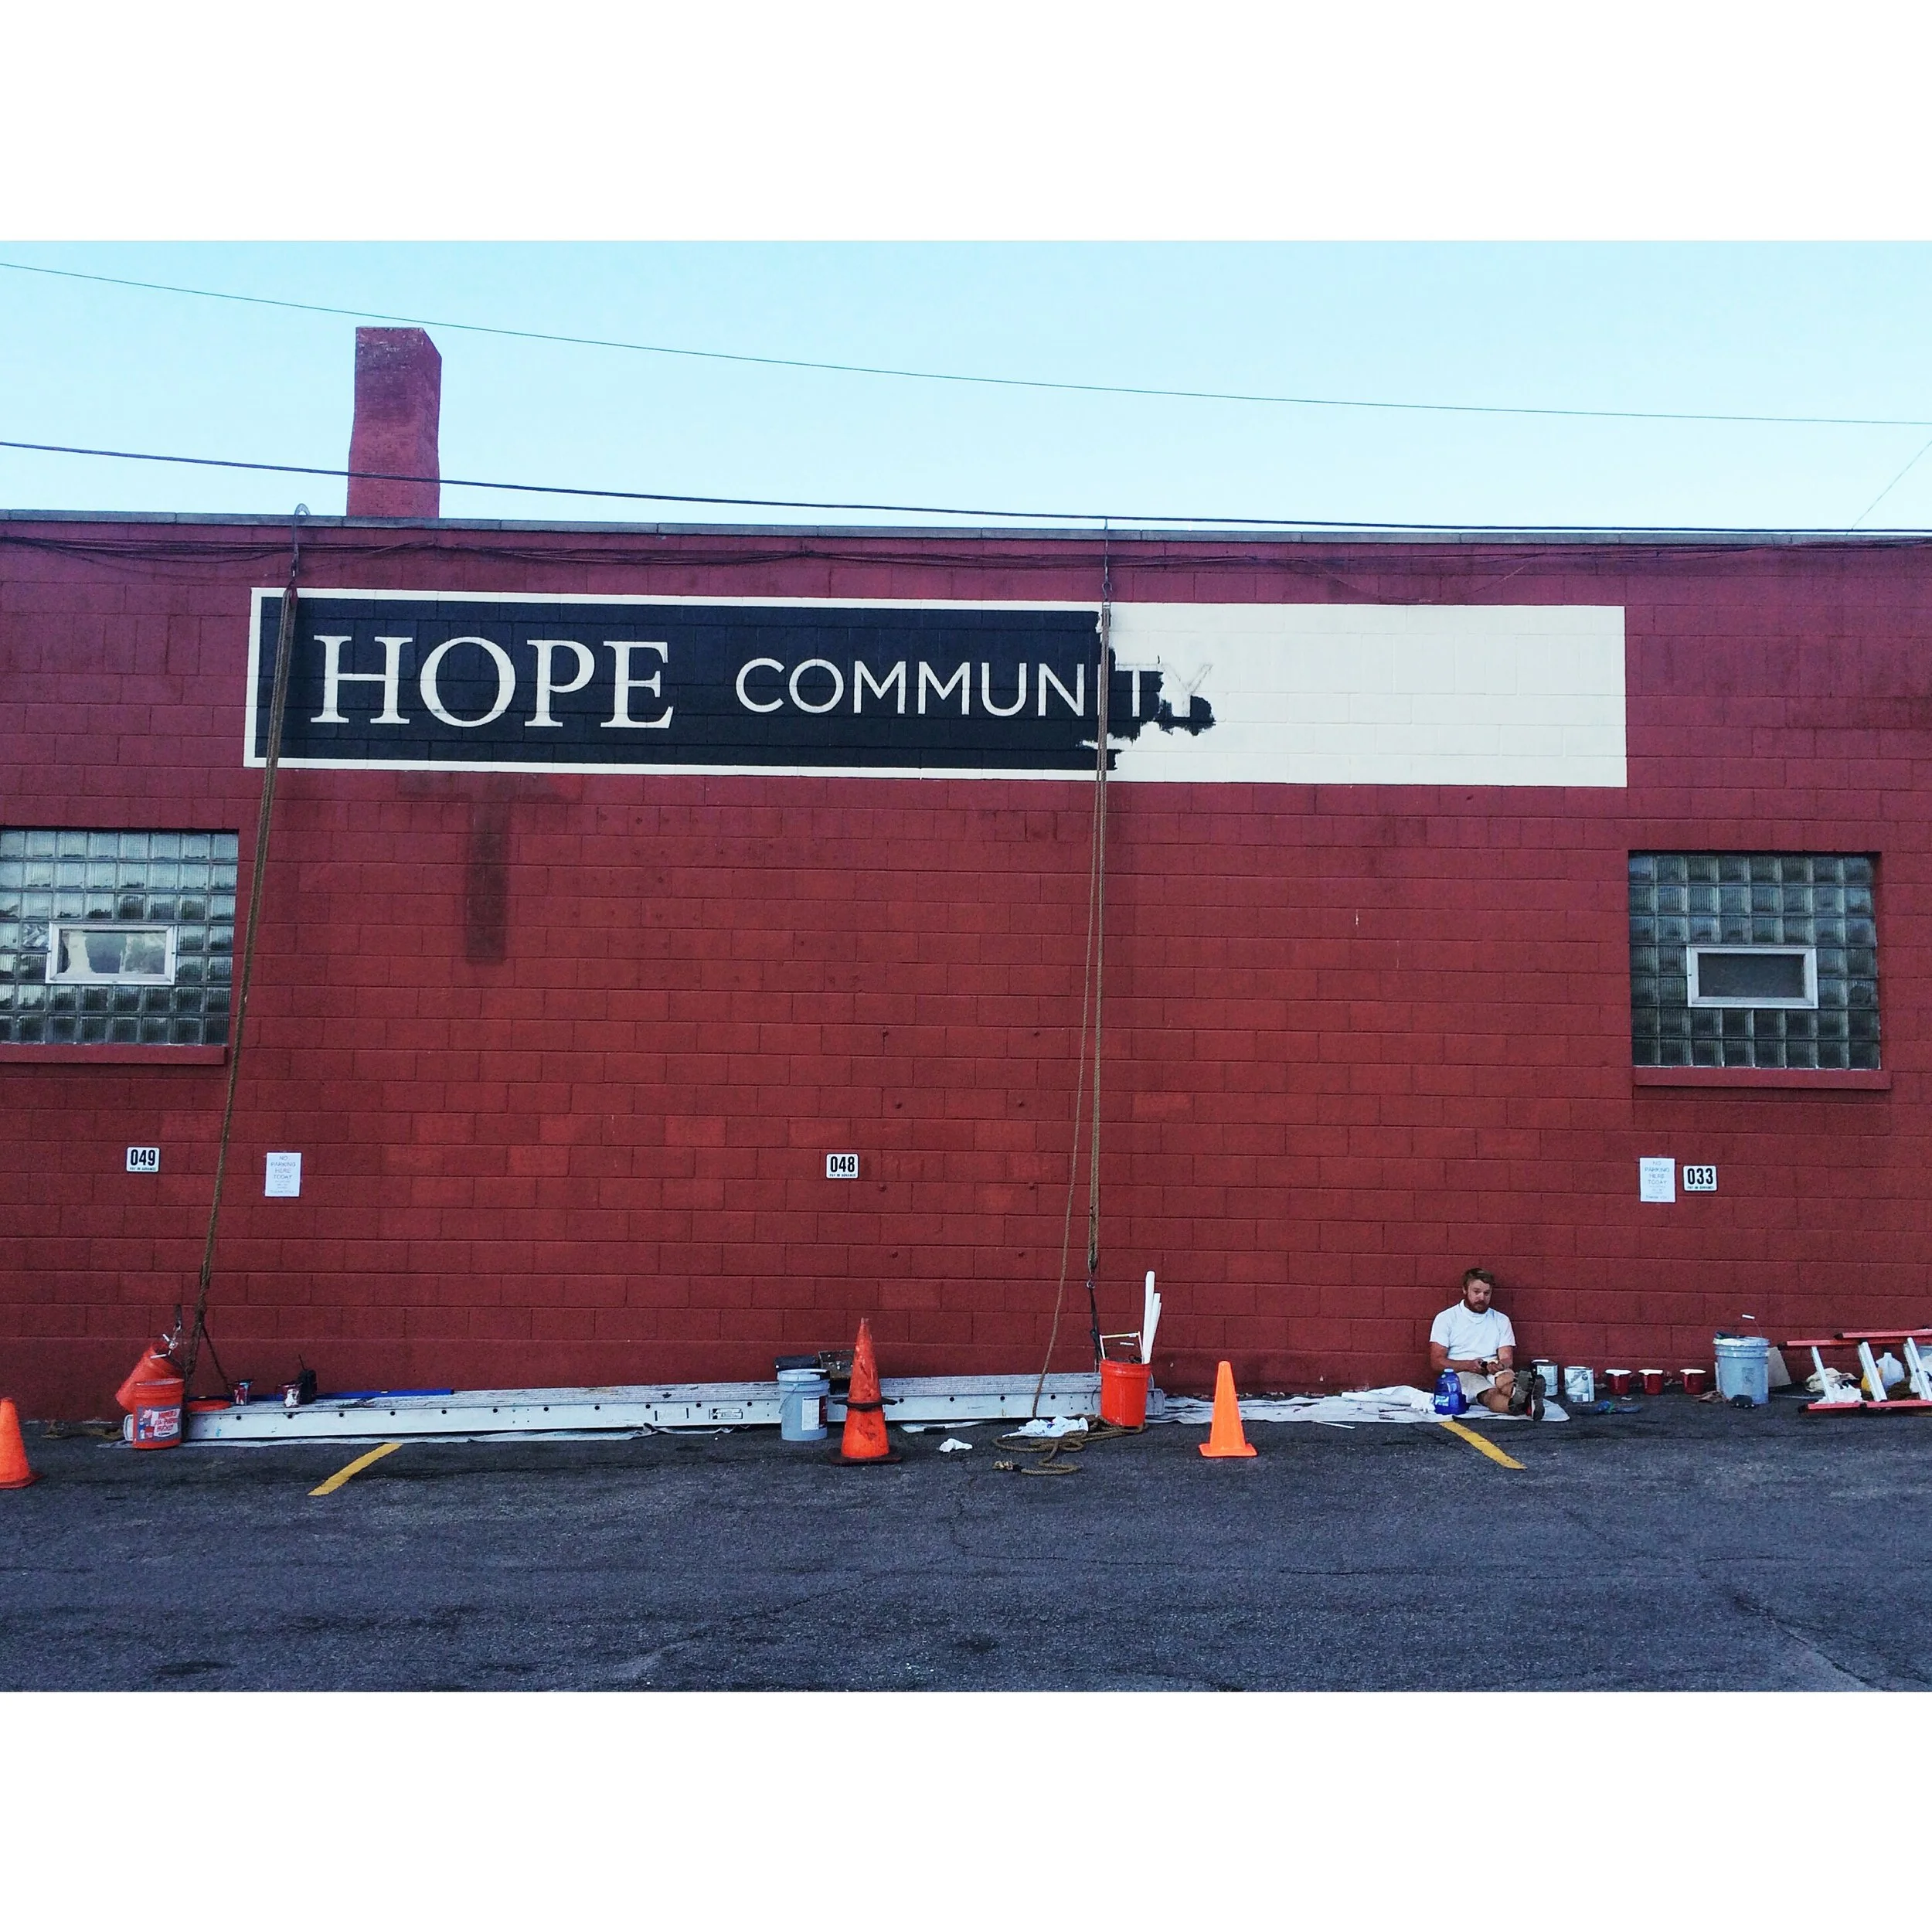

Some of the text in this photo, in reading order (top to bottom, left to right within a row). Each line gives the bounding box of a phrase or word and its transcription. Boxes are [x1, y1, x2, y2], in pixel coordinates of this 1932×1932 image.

[311, 634, 675, 730] HOPE
[131, 1148, 156, 1166] 049
[830, 1155, 855, 1172] 048
[1687, 1168, 1713, 1185] 033
